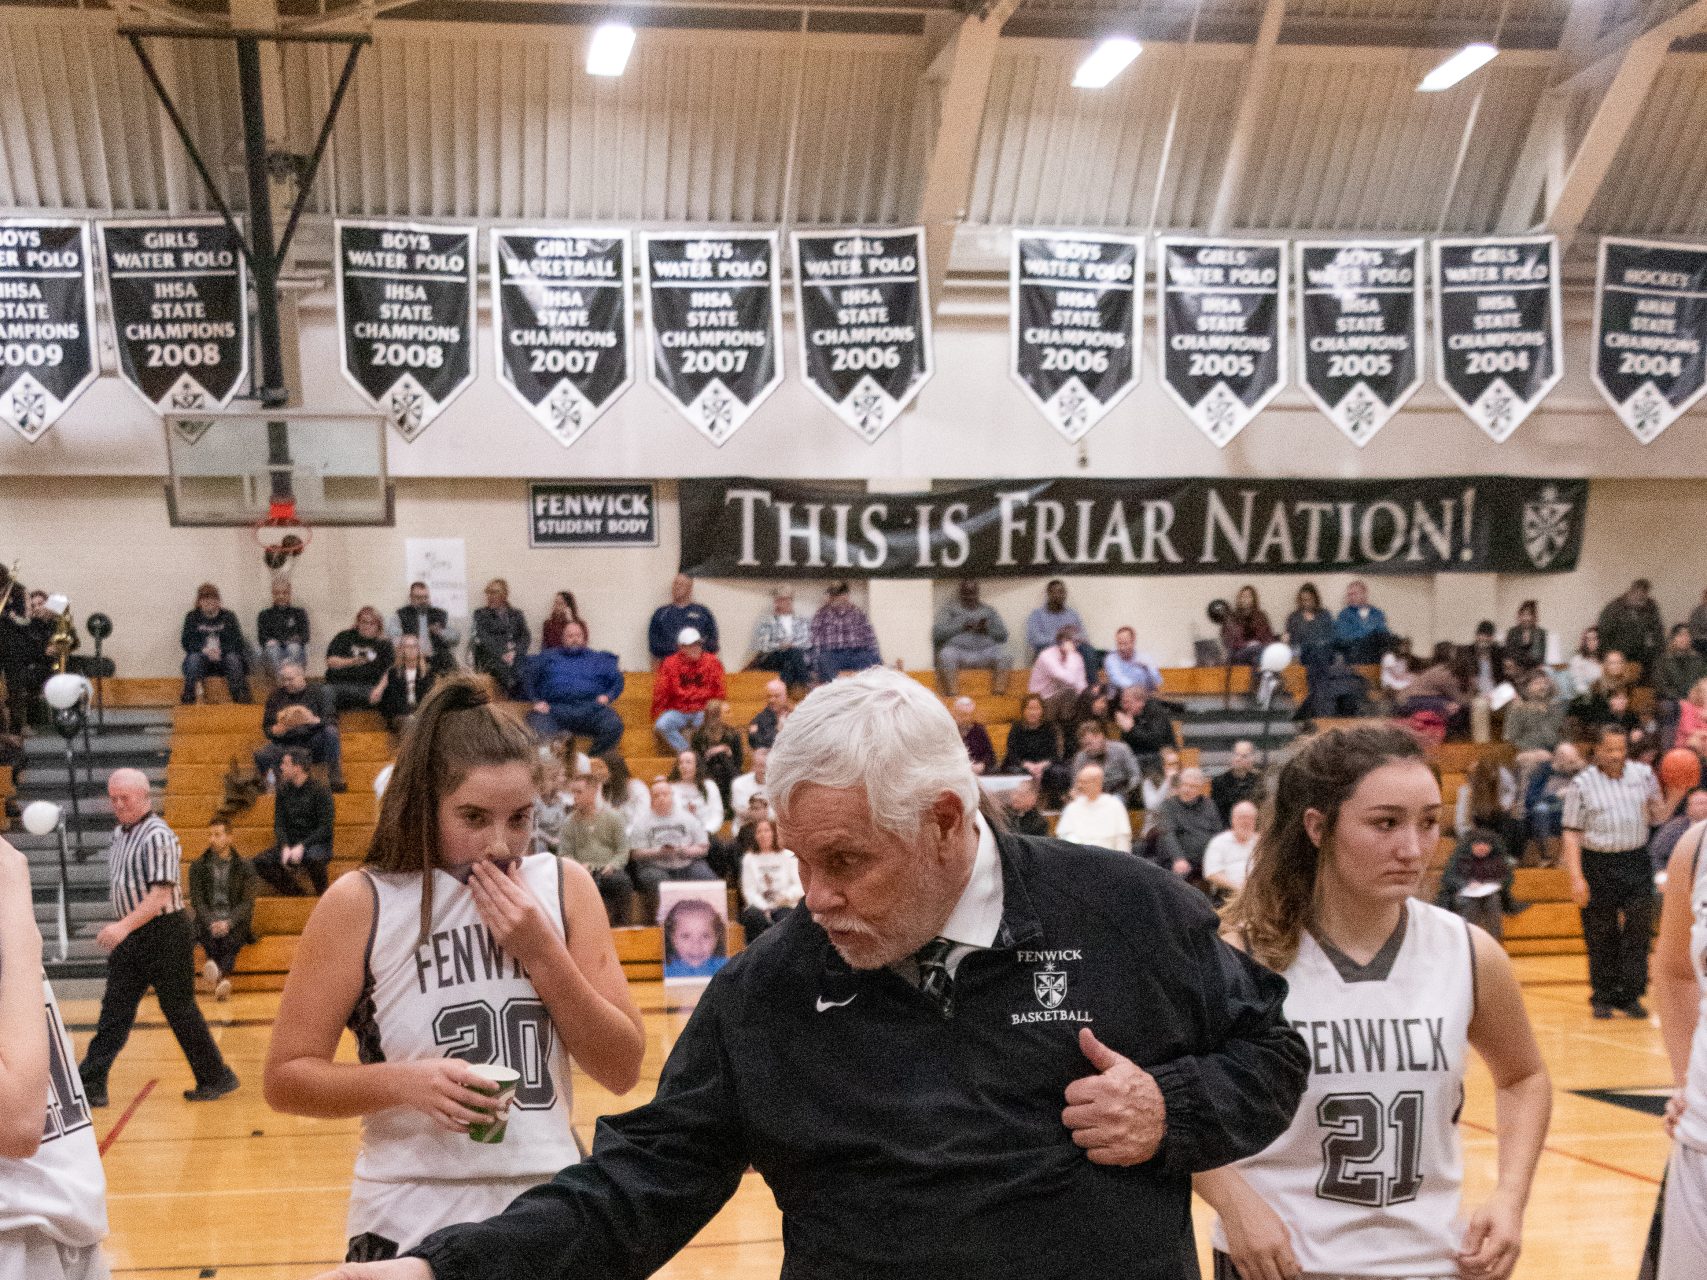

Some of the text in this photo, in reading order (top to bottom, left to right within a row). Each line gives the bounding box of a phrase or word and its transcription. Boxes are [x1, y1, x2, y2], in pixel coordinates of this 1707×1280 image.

[143, 232, 199, 248] GIRLS
[382, 234, 430, 250] BOYS
[535, 241, 588, 257] GIRLS
[833, 240, 885, 256] GIRLS
[28, 252, 79, 268] POLO
[113, 251, 233, 269] WATER POLO
[685, 243, 734, 259] BOYS
[1053, 243, 1101, 261] BOYS
[1196, 249, 1247, 265] GIRLS
[348, 251, 465, 273] WATER POLO
[507, 259, 617, 278] BASKETBALL
[653, 260, 767, 278] WATER POLO
[804, 256, 916, 277] WATER POLO
[1023, 260, 1133, 281] WATER POLO
[1168, 267, 1276, 285] WATER POLO
[1307, 267, 1413, 284] WATER POLO
[1444, 264, 1549, 282] WATER POLO
[155, 282, 199, 299] IHSA
[385, 285, 427, 301] IHSA
[543, 290, 584, 307] IHSA
[841, 289, 883, 305] IHSA
[1056, 291, 1098, 308] IHSA
[691, 292, 732, 308] IHSA
[1202, 298, 1242, 313] IHSA
[1341, 297, 1381, 313] IHSA
[1476, 296, 1517, 311] IHSA
[151, 303, 206, 319] STATE
[379, 303, 433, 321] STATE
[537, 309, 590, 327] STATE
[687, 311, 739, 327] STATE
[837, 307, 889, 325] STATE
[1051, 310, 1101, 327] STATE
[1197, 316, 1248, 332] STATE
[1335, 316, 1385, 332] STATE
[1473, 313, 1522, 330] STATE
[126, 323, 236, 340] CHAMPIONS
[354, 324, 461, 343] CHAMPIONS
[510, 329, 617, 348] CHAMPIONS
[661, 331, 766, 347] CHAMPIONS
[811, 326, 916, 346] CHAMPIONS
[1024, 328, 1126, 349] CHAMPIONS
[1171, 334, 1271, 351] CHAMPIONS
[1310, 335, 1410, 352] CHAMPIONS
[1449, 332, 1546, 350] CHAMPIONS
[0, 344, 64, 366] 009
[147, 343, 221, 367] 2008
[371, 344, 444, 368] 2008
[530, 351, 600, 373] 2007
[681, 350, 750, 373] 2007
[831, 347, 901, 371] 2006
[1041, 349, 1109, 373] 2006
[1465, 351, 1531, 375] 2004
[1188, 354, 1255, 377] 2005
[1327, 354, 1393, 377] 2005
[1618, 352, 1683, 377] 2004
[535, 493, 650, 519] FENWICK
[537, 518, 649, 535] STUDENT BODY
[725, 486, 1478, 569] THIS IS FRIAR NATION!
[1016, 950, 1083, 963] FENWICK
[1011, 1010, 1093, 1025] BASKETBALL
[1315, 1090, 1424, 1208] 21
